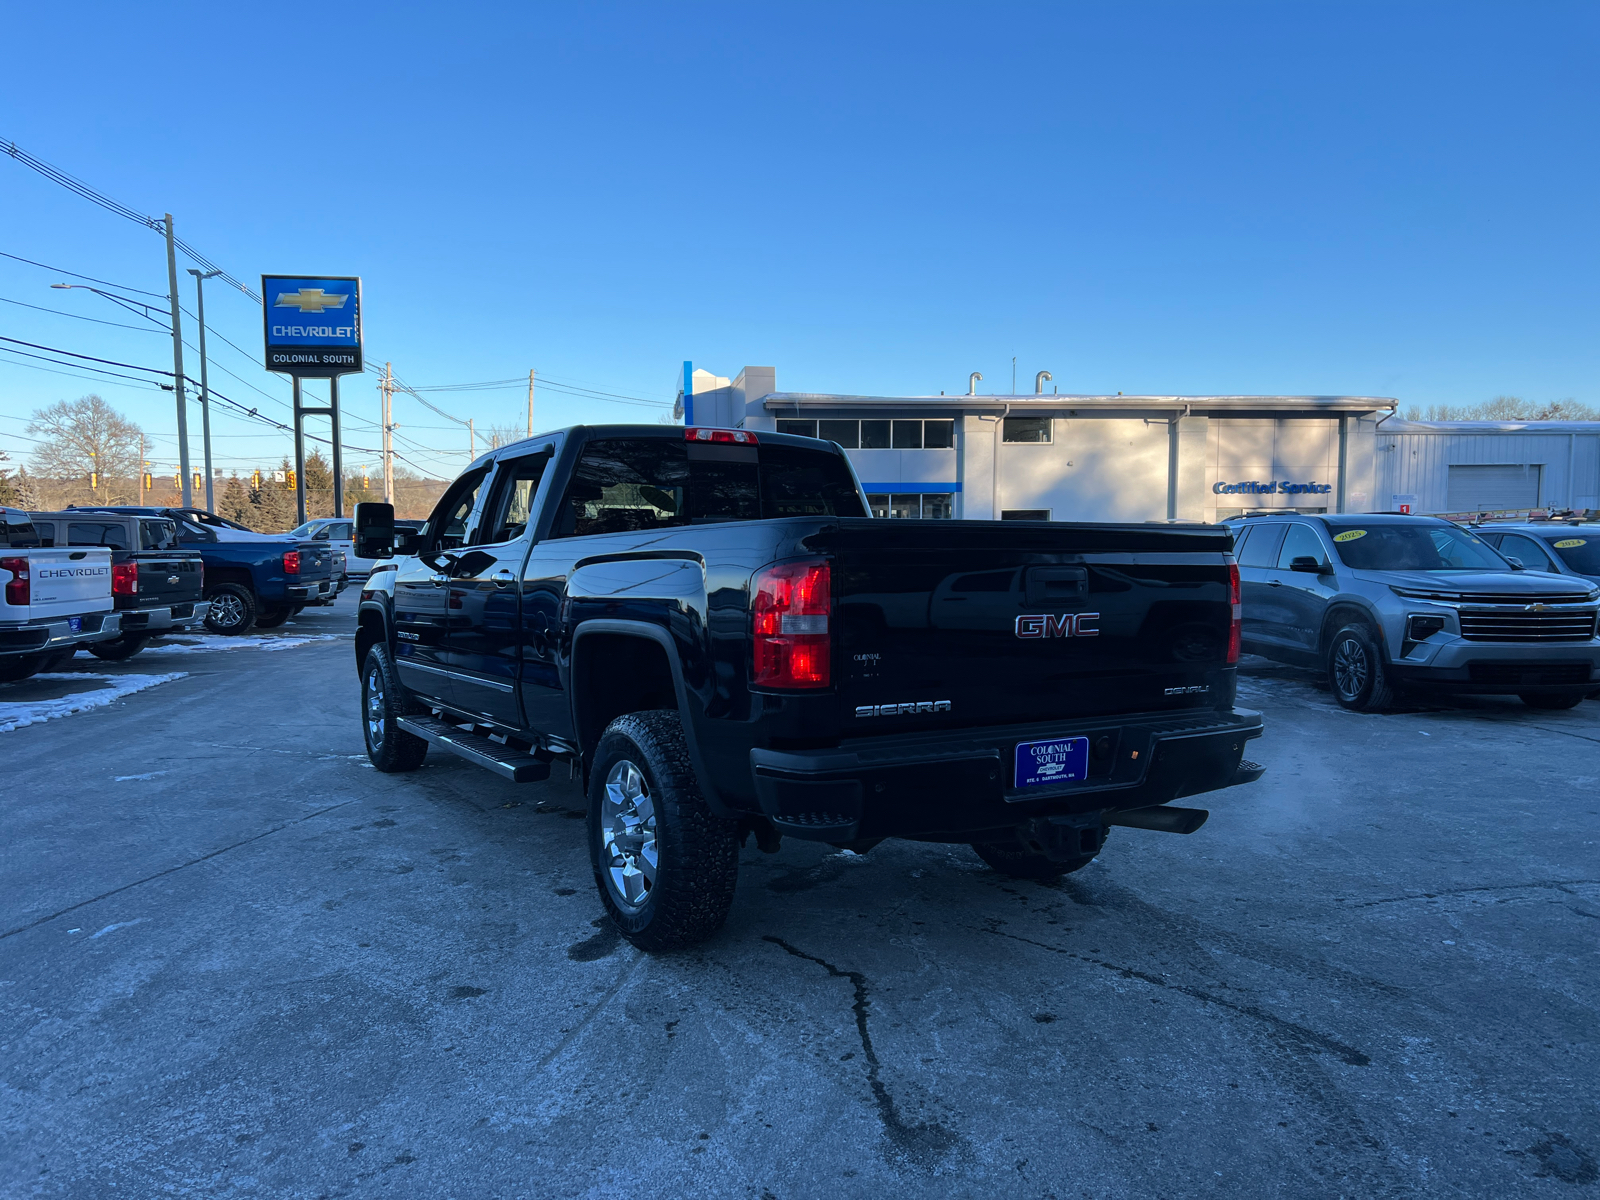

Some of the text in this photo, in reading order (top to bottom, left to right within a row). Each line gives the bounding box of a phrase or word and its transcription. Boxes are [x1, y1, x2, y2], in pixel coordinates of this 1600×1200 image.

[272, 325, 353, 338] CHEVROLET
[272, 354, 355, 364] COLONIAL SOUTH
[1214, 480, 1332, 495] Certified Service
[1339, 531, 1362, 541] 2025
[39, 567, 110, 579] CHEVROLET
[1015, 612, 1100, 639] GMC
[1164, 685, 1210, 696] DENALI
[855, 700, 952, 718] SIERRA
[1030, 744, 1073, 755] COLONIAL
[1036, 753, 1066, 764] SOUTH
